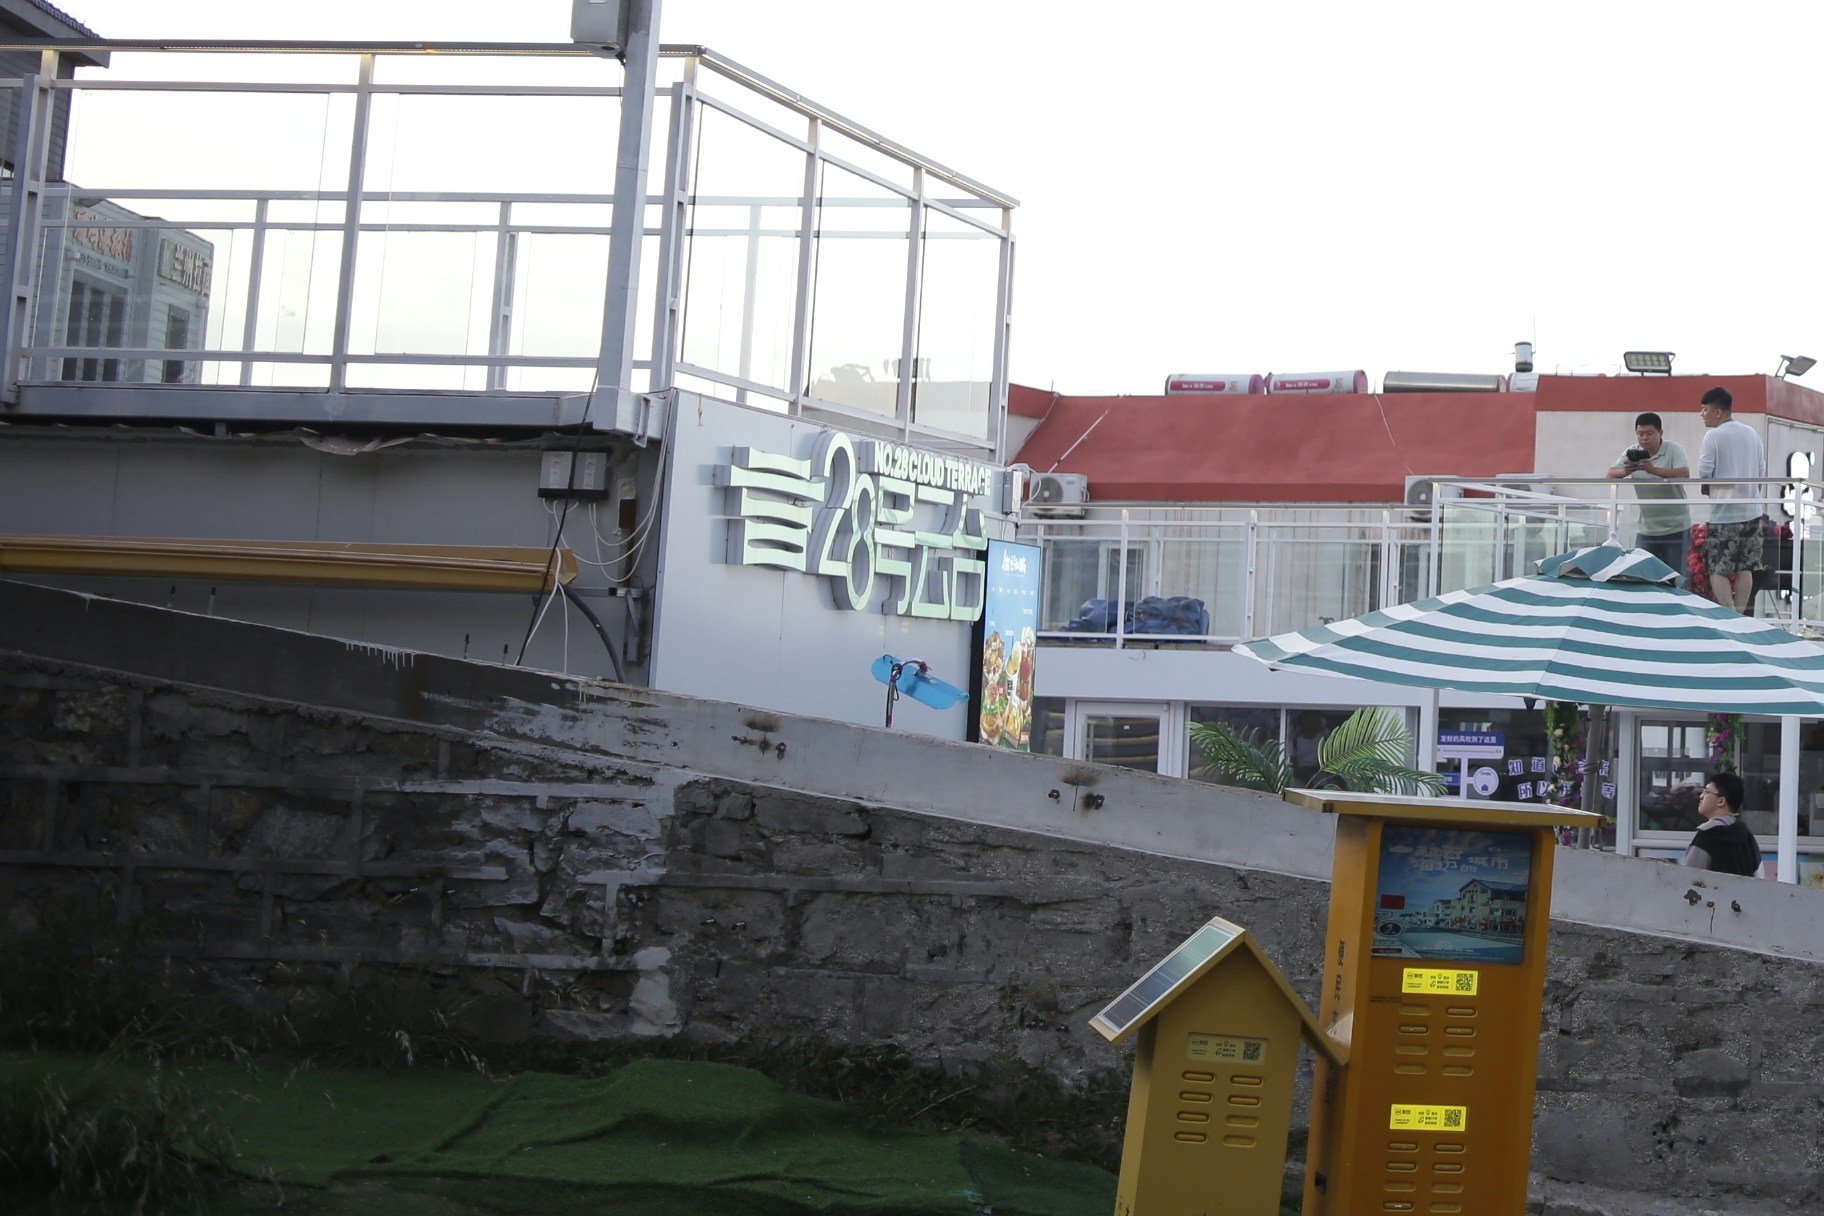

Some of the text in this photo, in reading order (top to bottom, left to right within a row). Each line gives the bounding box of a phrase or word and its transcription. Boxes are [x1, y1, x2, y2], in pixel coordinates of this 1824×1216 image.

[908, 451, 945, 487] CLOUD
[945, 459, 992, 496] TERRACE
[1440, 735, 1497, 744] 发财的风吹到了这里
